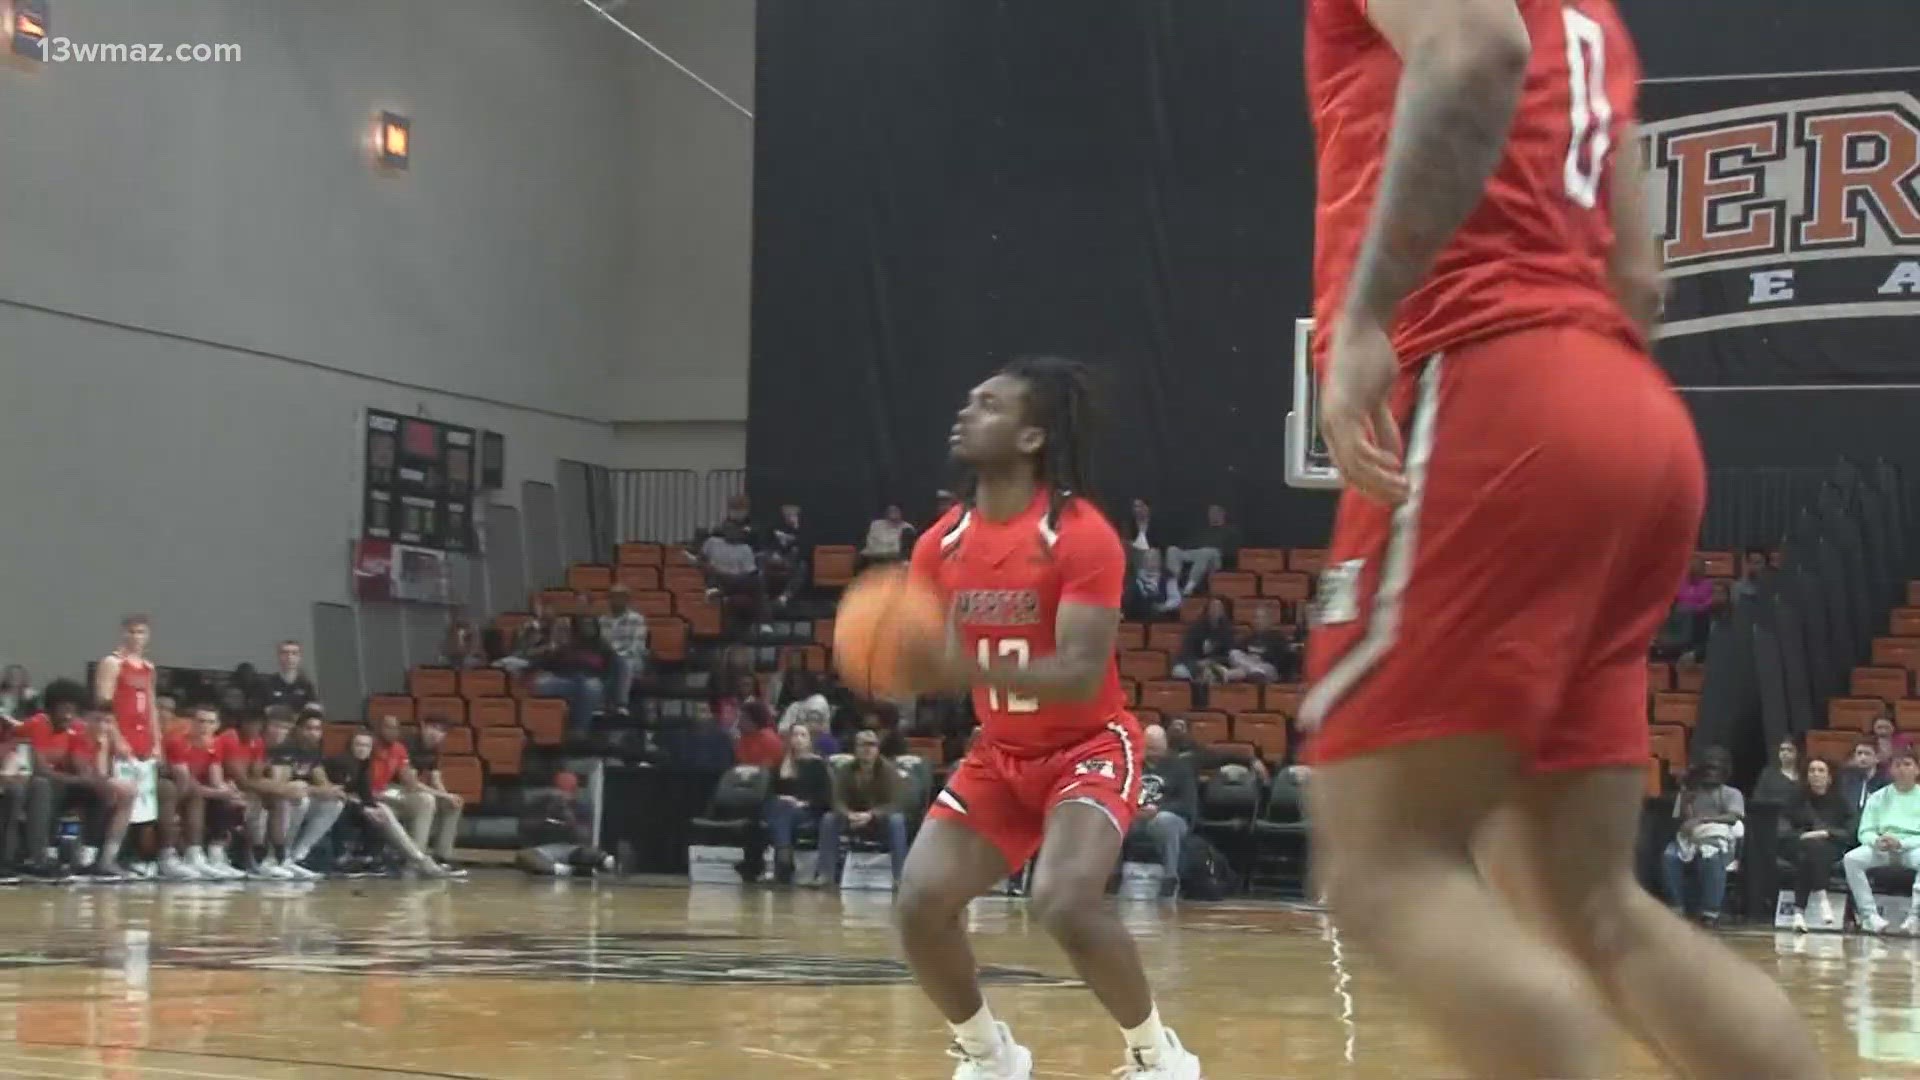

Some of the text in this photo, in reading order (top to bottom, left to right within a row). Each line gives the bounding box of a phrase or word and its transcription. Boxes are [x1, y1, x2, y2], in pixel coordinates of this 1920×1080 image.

[1562, 7, 1612, 208] 0
[1641, 103, 1920, 266] ER
[977, 638, 1039, 713] 12
